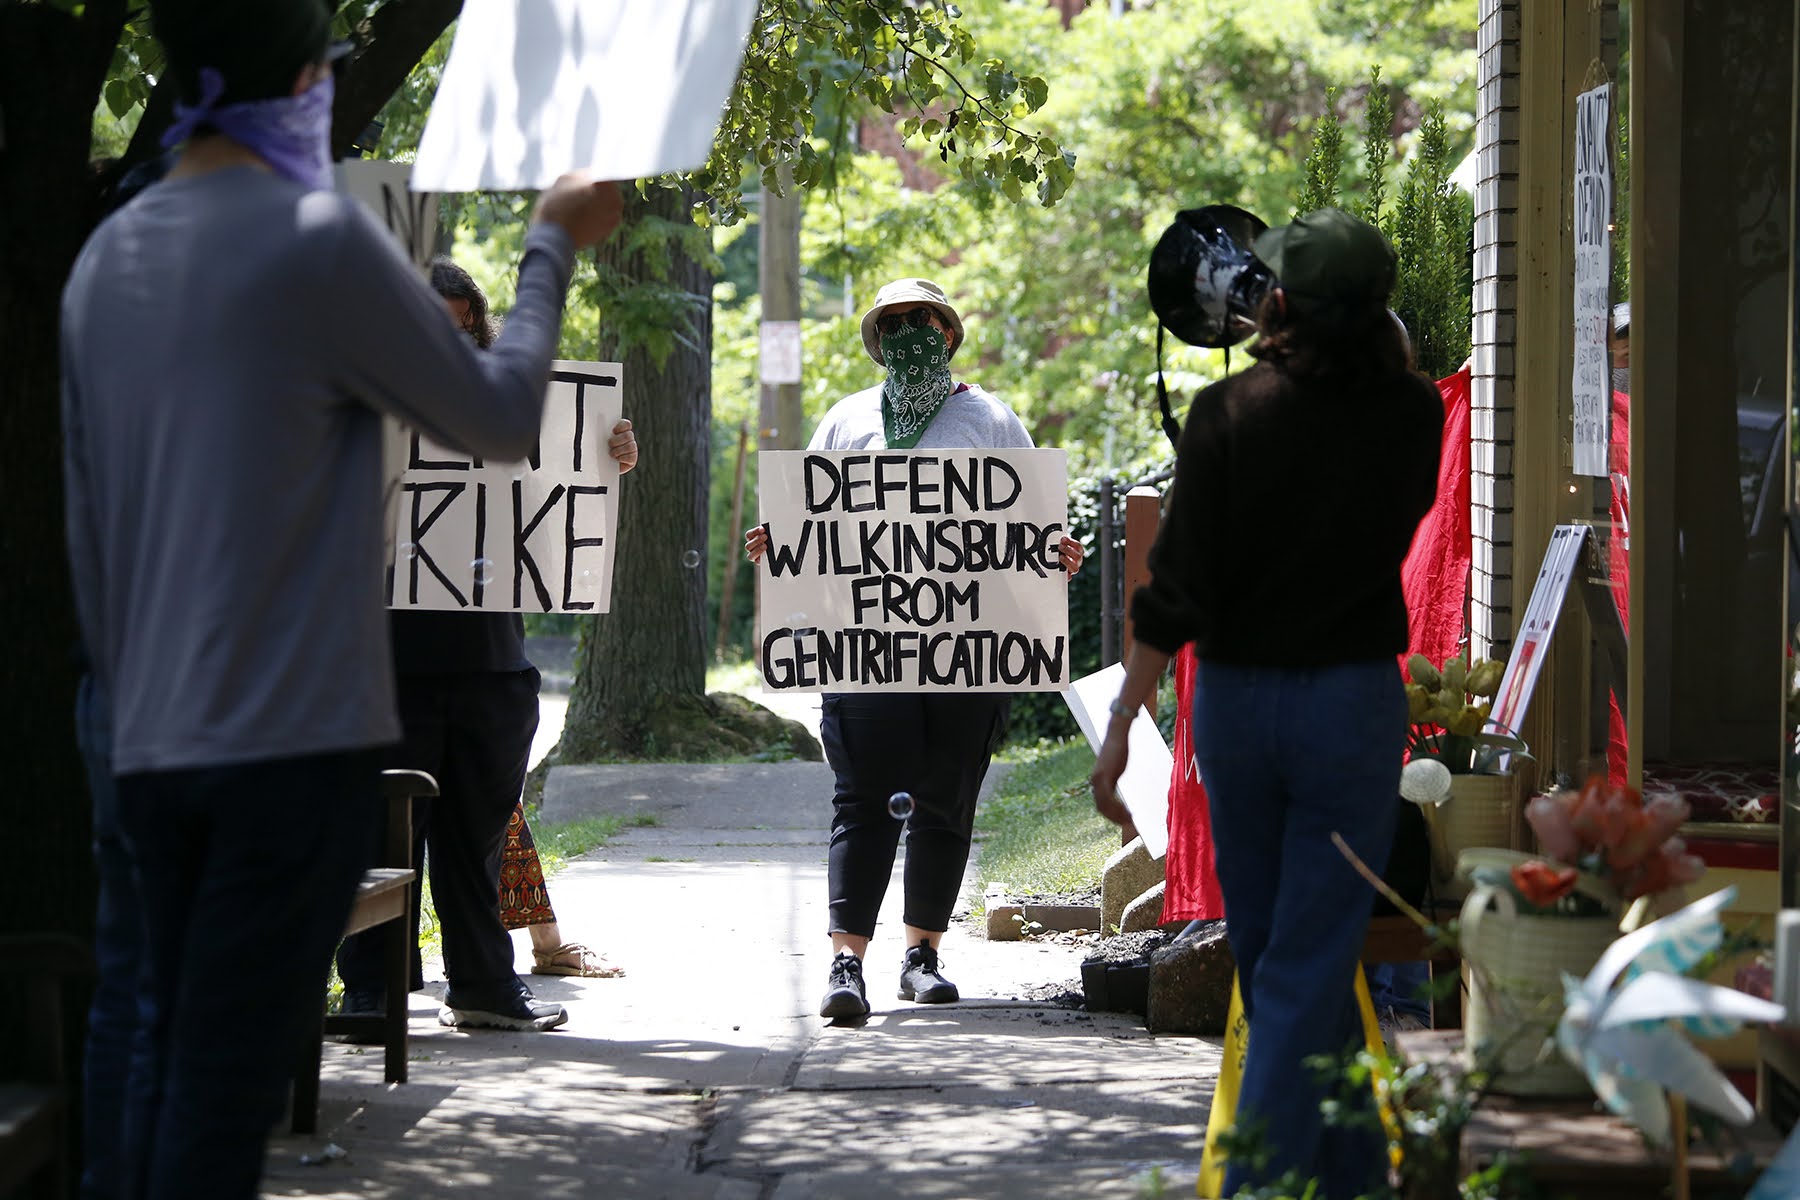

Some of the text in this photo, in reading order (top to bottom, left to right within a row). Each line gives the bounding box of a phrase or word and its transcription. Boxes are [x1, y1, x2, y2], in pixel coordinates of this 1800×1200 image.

[803, 455, 1022, 514] DEFEND
[386, 481, 608, 613] RIKE
[762, 519, 1066, 578] WILKINSBURG
[851, 574, 980, 627] FROM
[762, 627, 1064, 689] GENTRIFICATION
